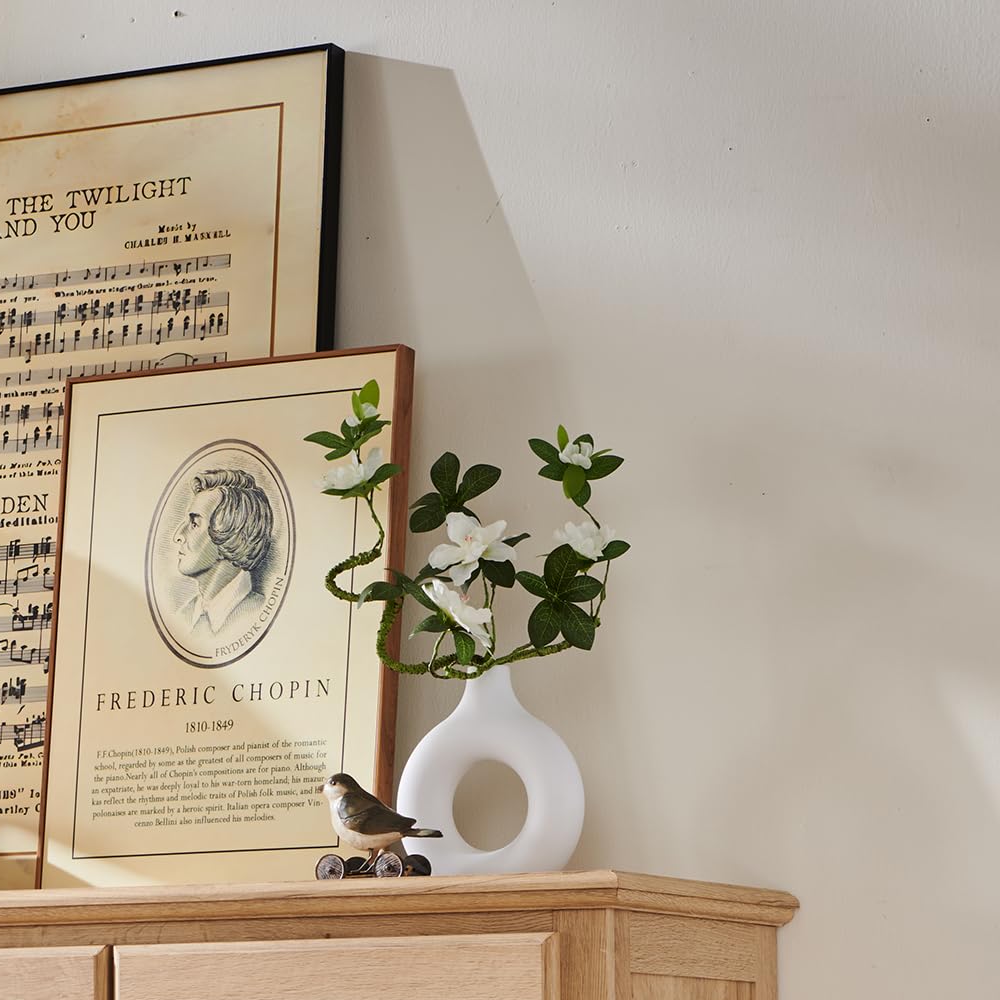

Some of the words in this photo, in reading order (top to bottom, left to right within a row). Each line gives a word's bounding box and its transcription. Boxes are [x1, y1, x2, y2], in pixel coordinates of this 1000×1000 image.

[7, 193, 54, 216] THE
[66, 176, 192, 209] TWILIGHT
[50, 210, 96, 232] YOU
[187, 221, 197, 232] by
[215, 622, 261, 657] FRYDERYK
[259, 577, 284, 623] CHOPIN
[96, 685, 216, 712] FREDERIC
[231, 678, 331, 703] CHOPIN
[185, 719, 234, 733] 1810-1849
[176, 744, 196, 754] Polish
[197, 745, 231, 755] composer
[232, 741, 246, 750] and
[246, 742, 270, 753] pianist
[271, 740, 280, 749] of
[281, 739, 292, 748] the
[294, 739, 327, 748] romantic
[93, 773, 104, 782] the
[149, 770, 158, 779] all
[159, 769, 168, 778] of
[169, 768, 197, 780] Chopin's
[199, 767, 244, 779] compositions
[258, 764, 269, 773] for
[294, 761, 327, 774] Although
[94, 762, 117, 771] school,
[118, 759, 147, 772] regarded
[148, 760, 156, 770] by
[185, 757, 196, 765] the
[197, 757, 224, 768] greatest
[225, 754, 234, 763] of
[235, 754, 244, 763] all
[246, 753, 282, 764] composers
[284, 752, 292, 760] of
[293, 752, 314, 760] music
[316, 750, 327, 759] for
[91, 797, 102, 806] kas
[103, 796, 125, 805] reflect
[126, 795, 137, 804] the
[138, 794, 165, 806] rhythms
[166, 792, 179, 801] and
[180, 791, 207, 801] melodic
[209, 791, 227, 800] traits
[228, 789, 237, 798] of
[237, 788, 257, 798] Polish
[259, 787, 274, 797] folk
[276, 788, 299, 797] music,
[300, 786, 313, 795] and
[101, 786, 135, 796] expatriate,
[136, 783, 145, 792] he
[159, 781, 182, 793] deeply
[183, 779, 200, 792] loyal
[210, 778, 220, 788] his
[221, 779, 252, 787] war-torn
[291, 774, 301, 784] his
[92, 809, 126, 820] polonaises
[140, 806, 165, 815] marked
[167, 805, 175, 816] by
[182, 804, 204, 813] heroic
[205, 803, 225, 815] spirit.
[227, 802, 249, 811] Italian
[251, 802, 270, 812] opera
[272, 800, 306, 811] composer
[307, 798, 324, 807] Vin-
[155, 815, 177, 827] Bellini
[179, 816, 193, 825] also
[194, 814, 231, 824] influenced
[232, 814, 242, 823] his
[243, 812, 275, 822] melodies.
